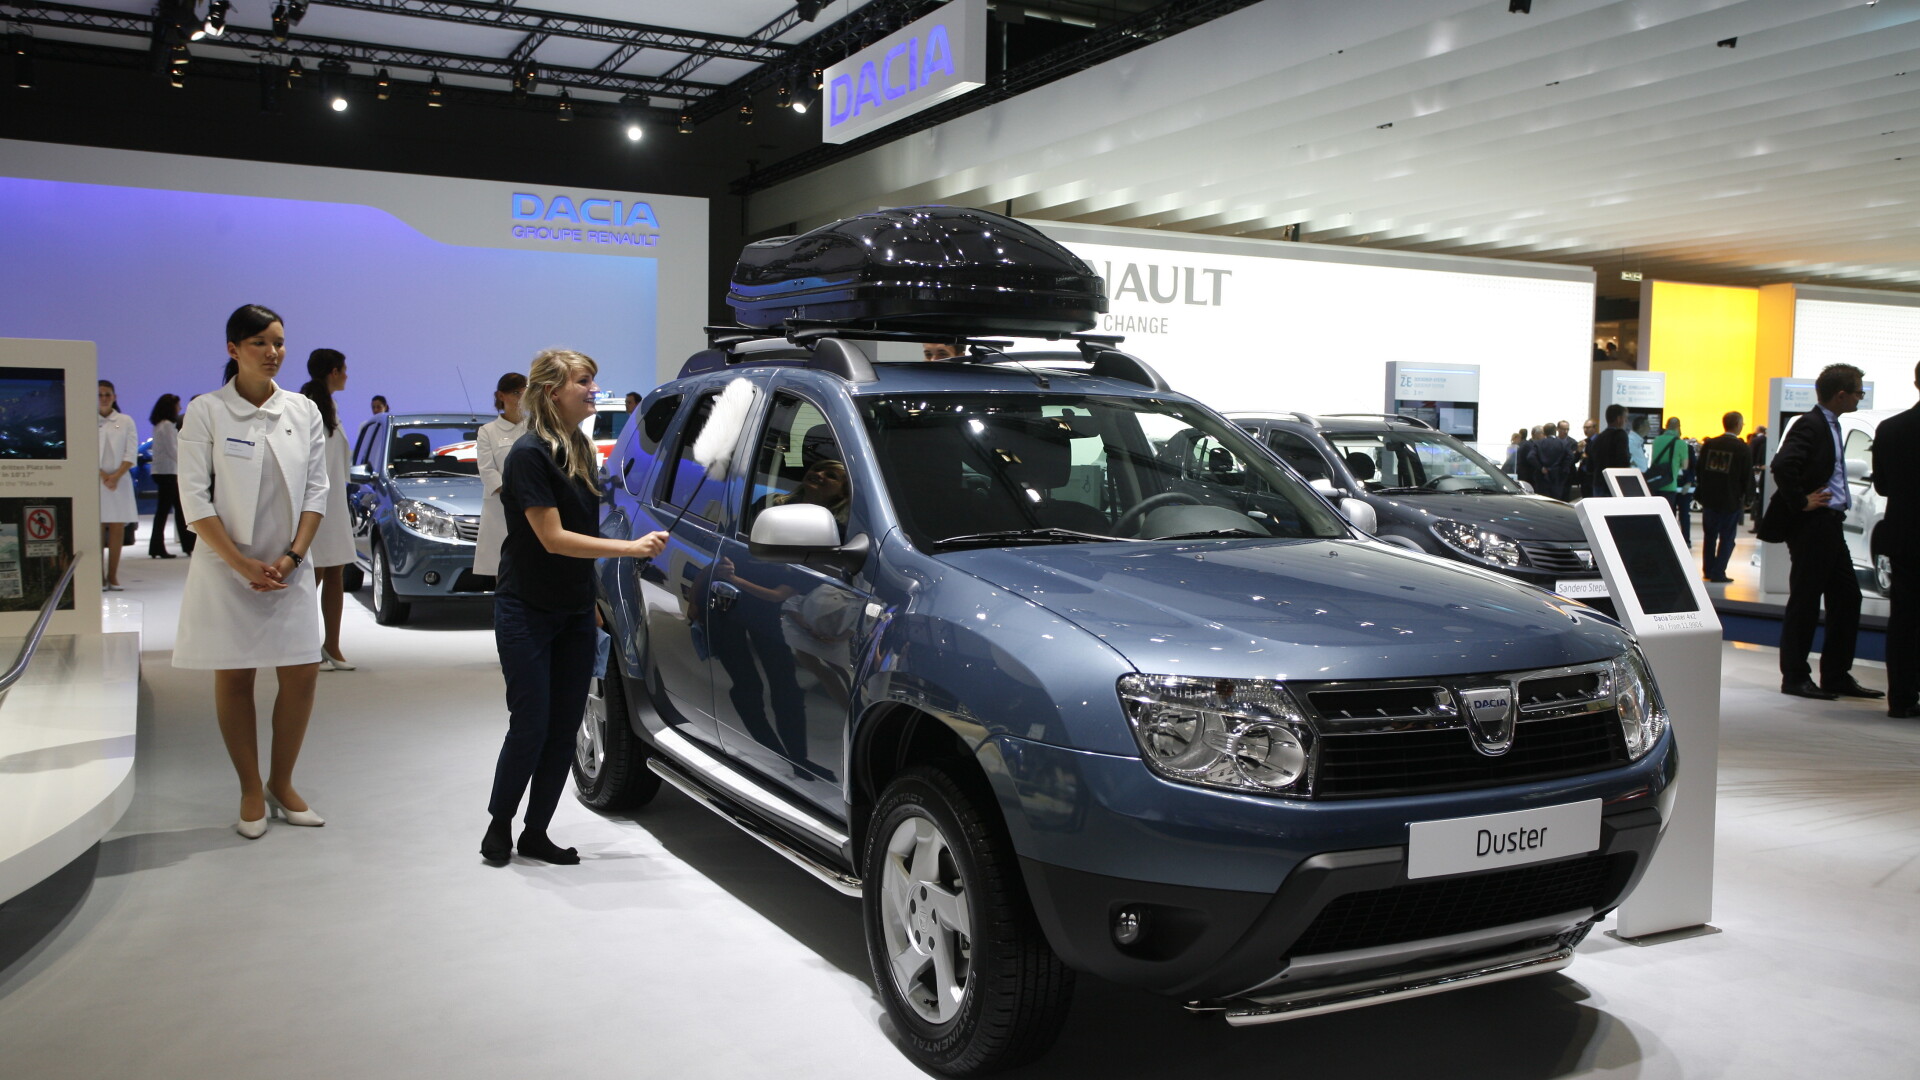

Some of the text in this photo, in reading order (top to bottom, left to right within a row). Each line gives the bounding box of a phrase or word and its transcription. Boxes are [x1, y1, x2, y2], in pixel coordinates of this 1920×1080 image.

[830, 24, 955, 127] DACIA
[511, 192, 660, 228] DACIA
[511, 225, 660, 248] GROUPE RENAULT
[1103, 314, 1169, 335] CHANGE
[1558, 583, 1587, 593] Sandero
[1474, 698, 1508, 709] DACIA
[1476, 826, 1548, 857] Duster
